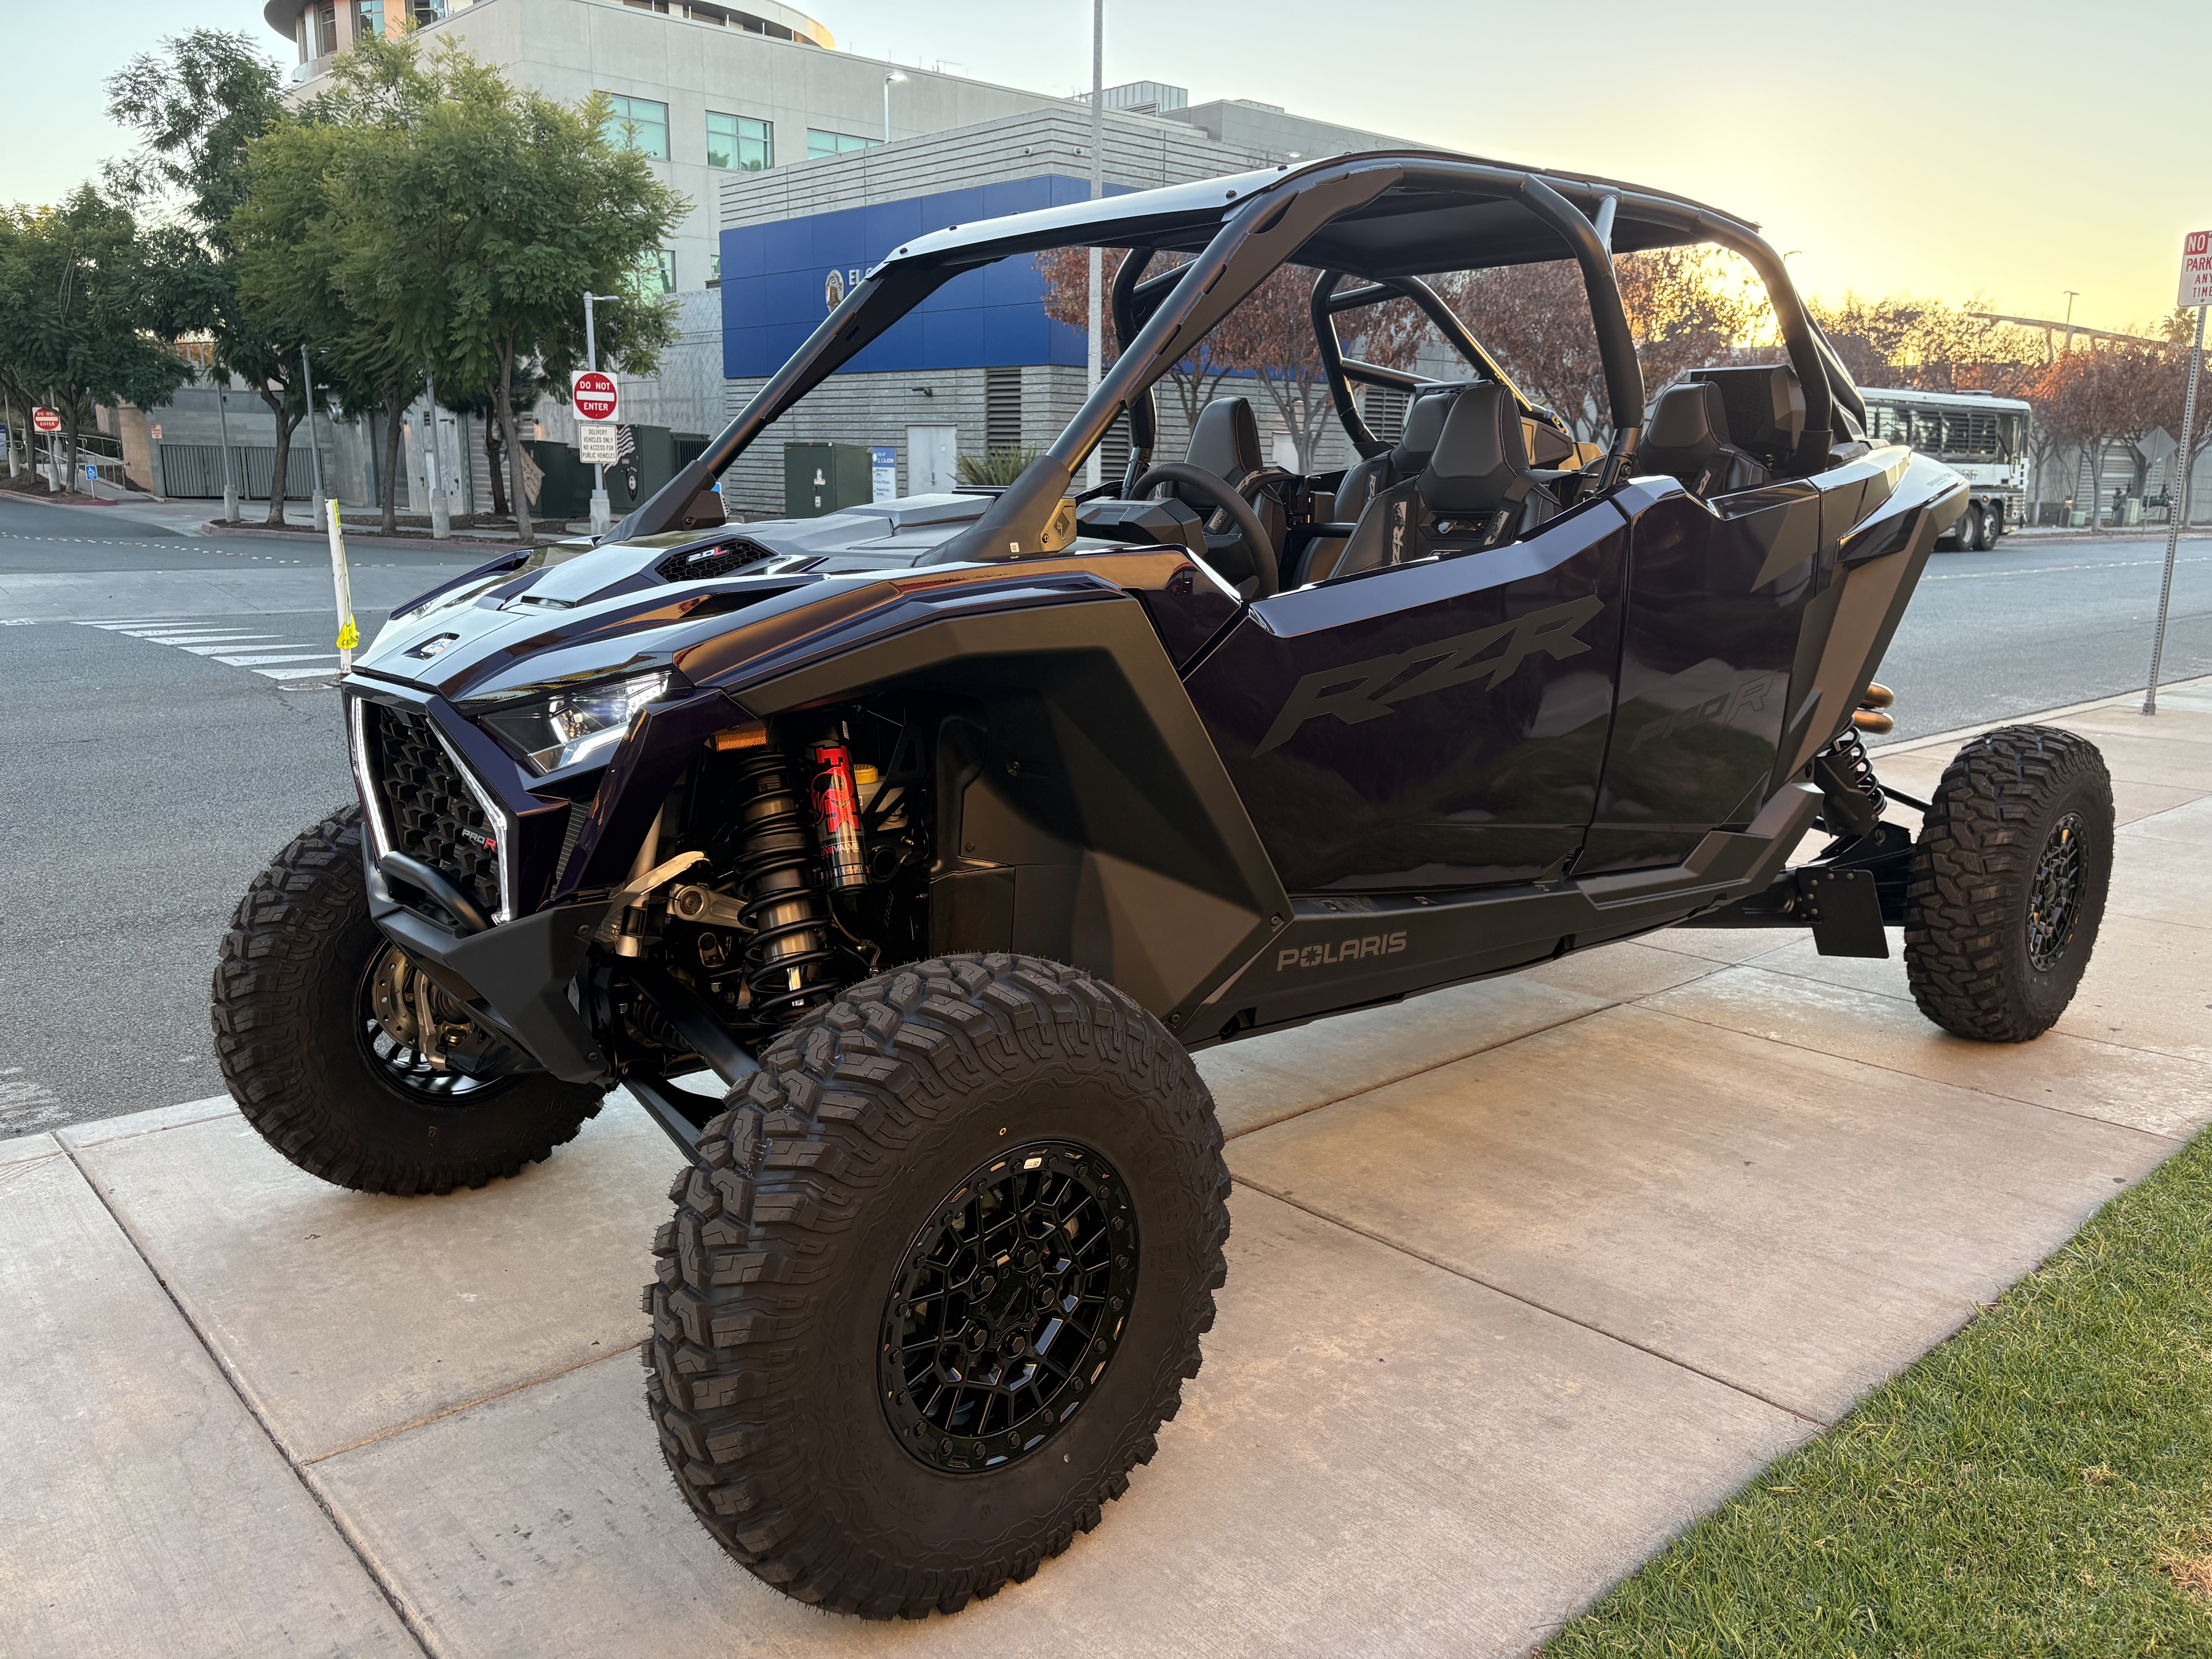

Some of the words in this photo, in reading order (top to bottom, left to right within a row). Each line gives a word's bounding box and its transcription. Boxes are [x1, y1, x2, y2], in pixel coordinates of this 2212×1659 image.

[2188, 235, 2205, 252] NO
[849, 270, 860, 285] EL
[580, 381, 591, 390] DO
[596, 382, 611, 390] NOT
[584, 402, 608, 411] ENTER
[1250, 595, 1605, 759] RZR
[813, 745, 860, 833] FOX
[1277, 931, 1407, 972] POLARIS
